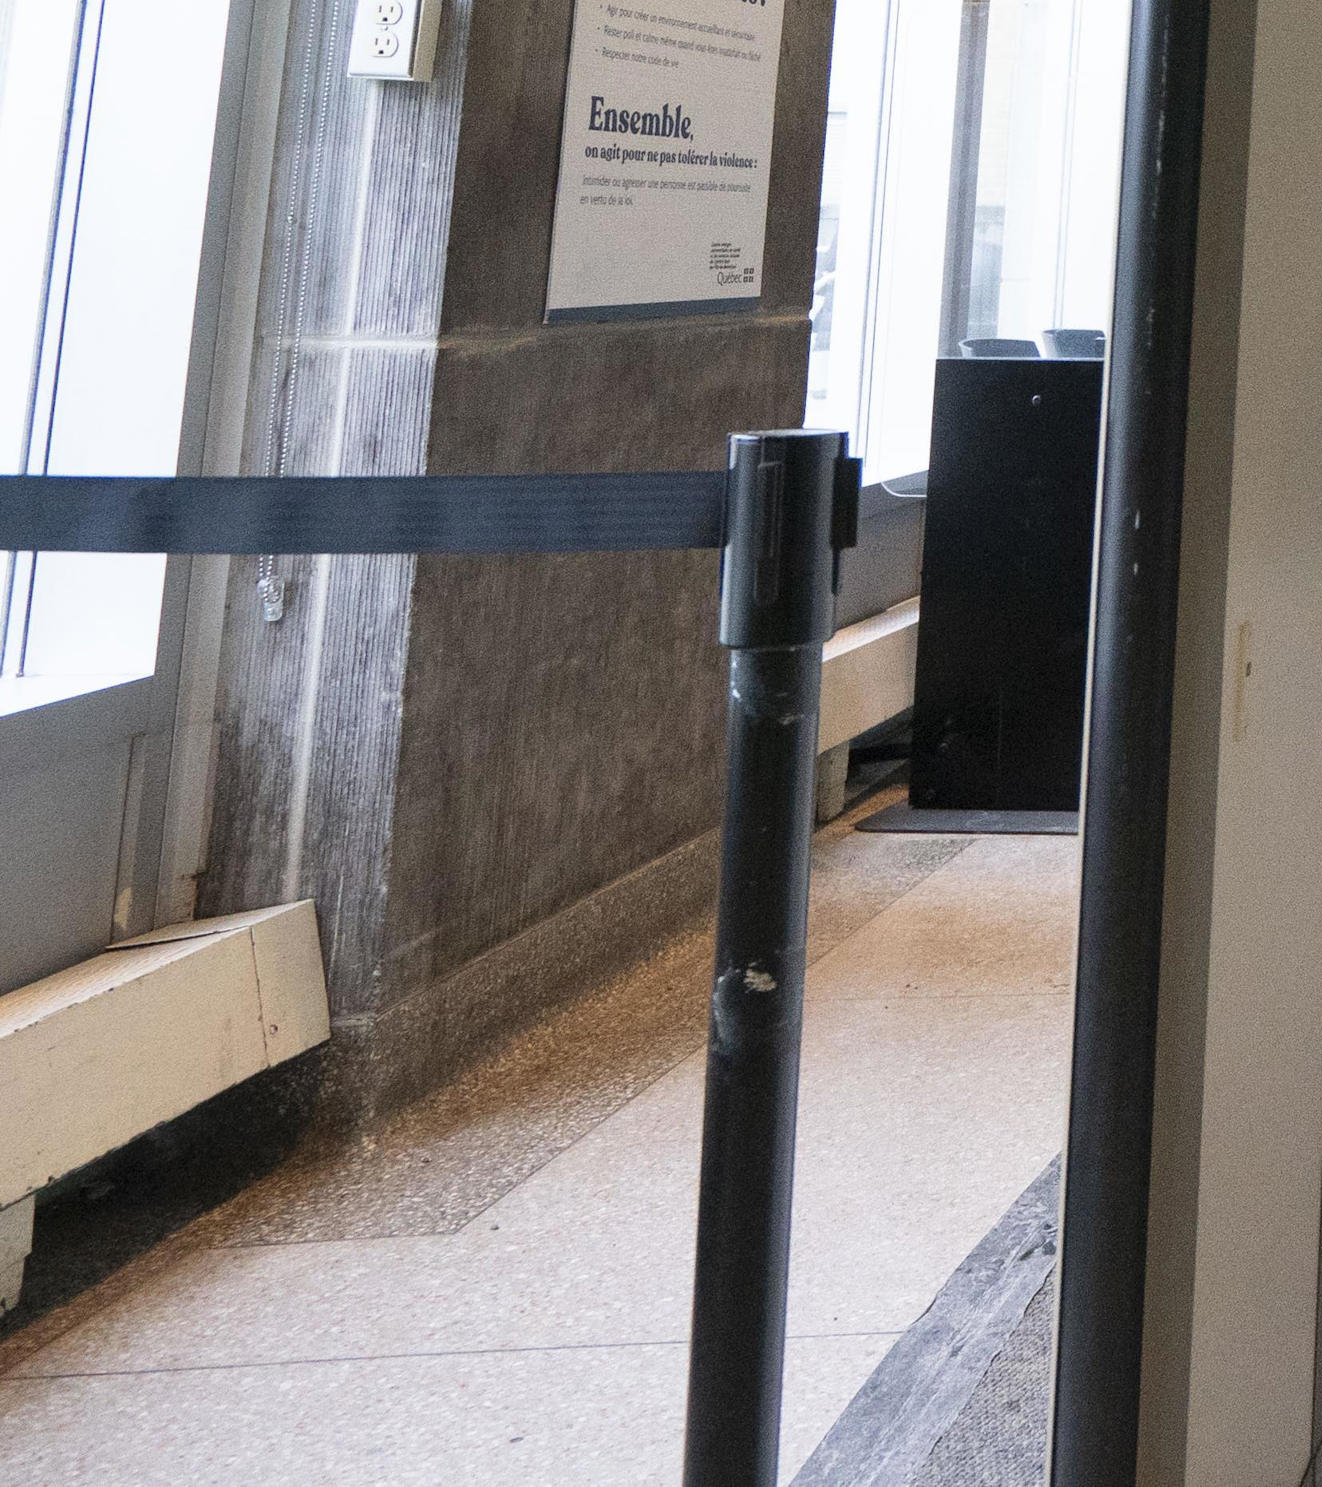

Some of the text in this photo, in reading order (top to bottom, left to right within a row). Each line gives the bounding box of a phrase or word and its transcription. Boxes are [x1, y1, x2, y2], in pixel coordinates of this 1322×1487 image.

[588, 95, 695, 142] Ensemble,
[585, 145, 599, 159] on
[600, 143, 621, 162] agit
[621, 149, 646, 165] pour
[647, 151, 658, 162] ne
[659, 152, 676, 167] pas
[677, 149, 709, 166] tolérer
[709, 150, 718, 167] la
[716, 269, 743, 287] Québec
